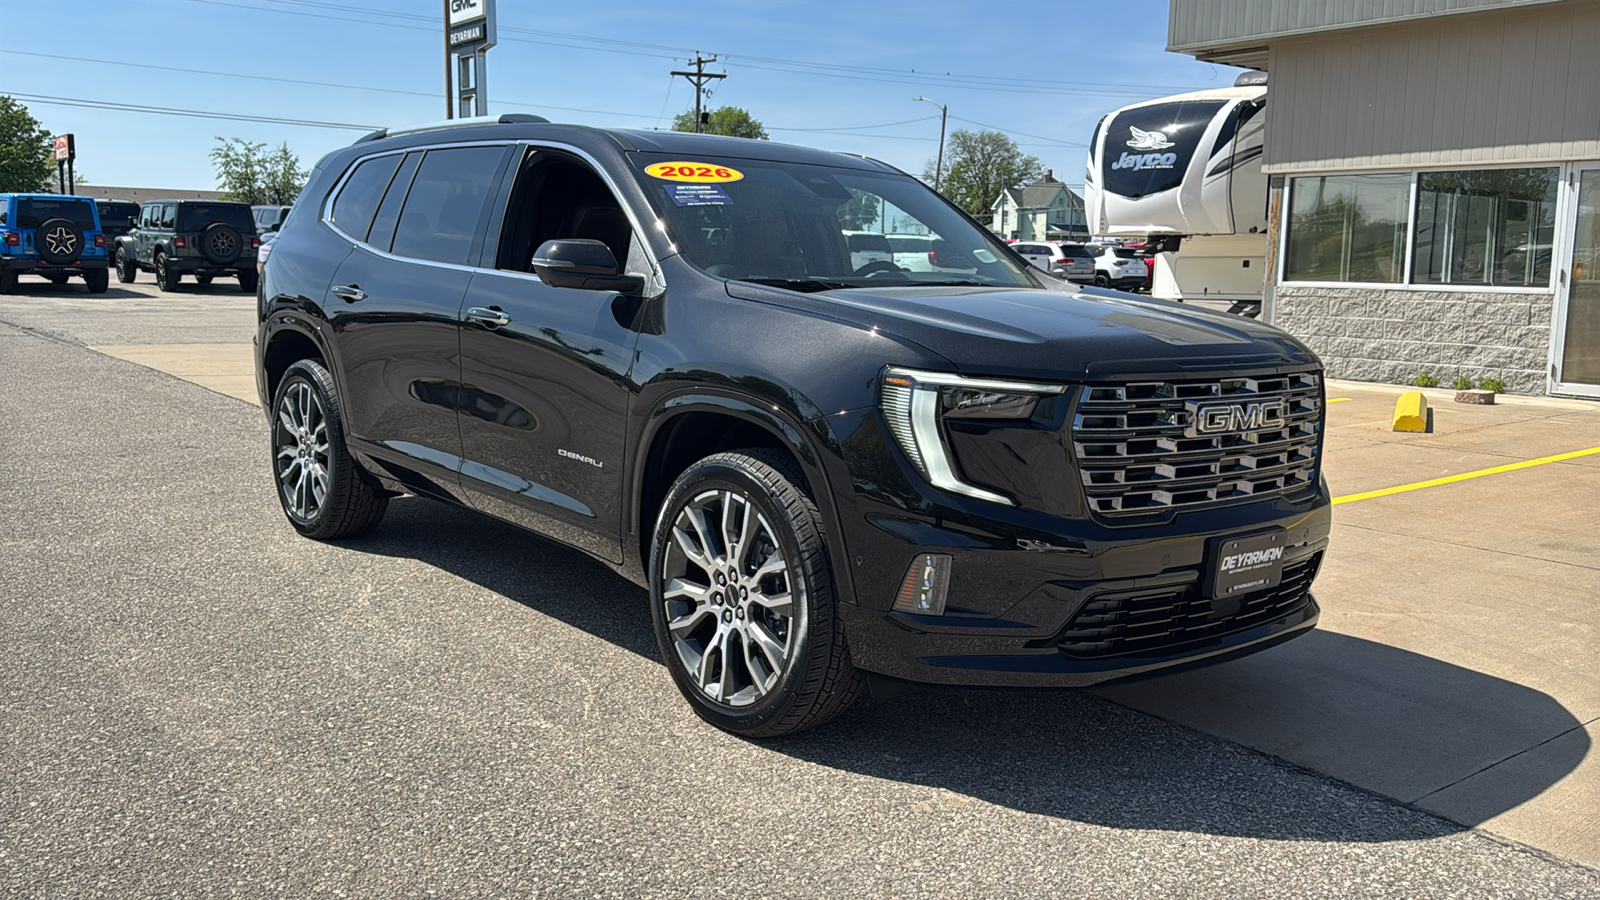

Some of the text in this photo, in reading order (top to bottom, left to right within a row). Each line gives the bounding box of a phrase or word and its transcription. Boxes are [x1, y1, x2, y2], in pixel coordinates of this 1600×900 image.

[450, 26, 480, 44] DEYARMAN
[1111, 151, 1177, 171] Jayco
[659, 166, 732, 178] 2026
[1199, 402, 1285, 432] GMC
[1220, 546, 1284, 571] DEYARMAN
